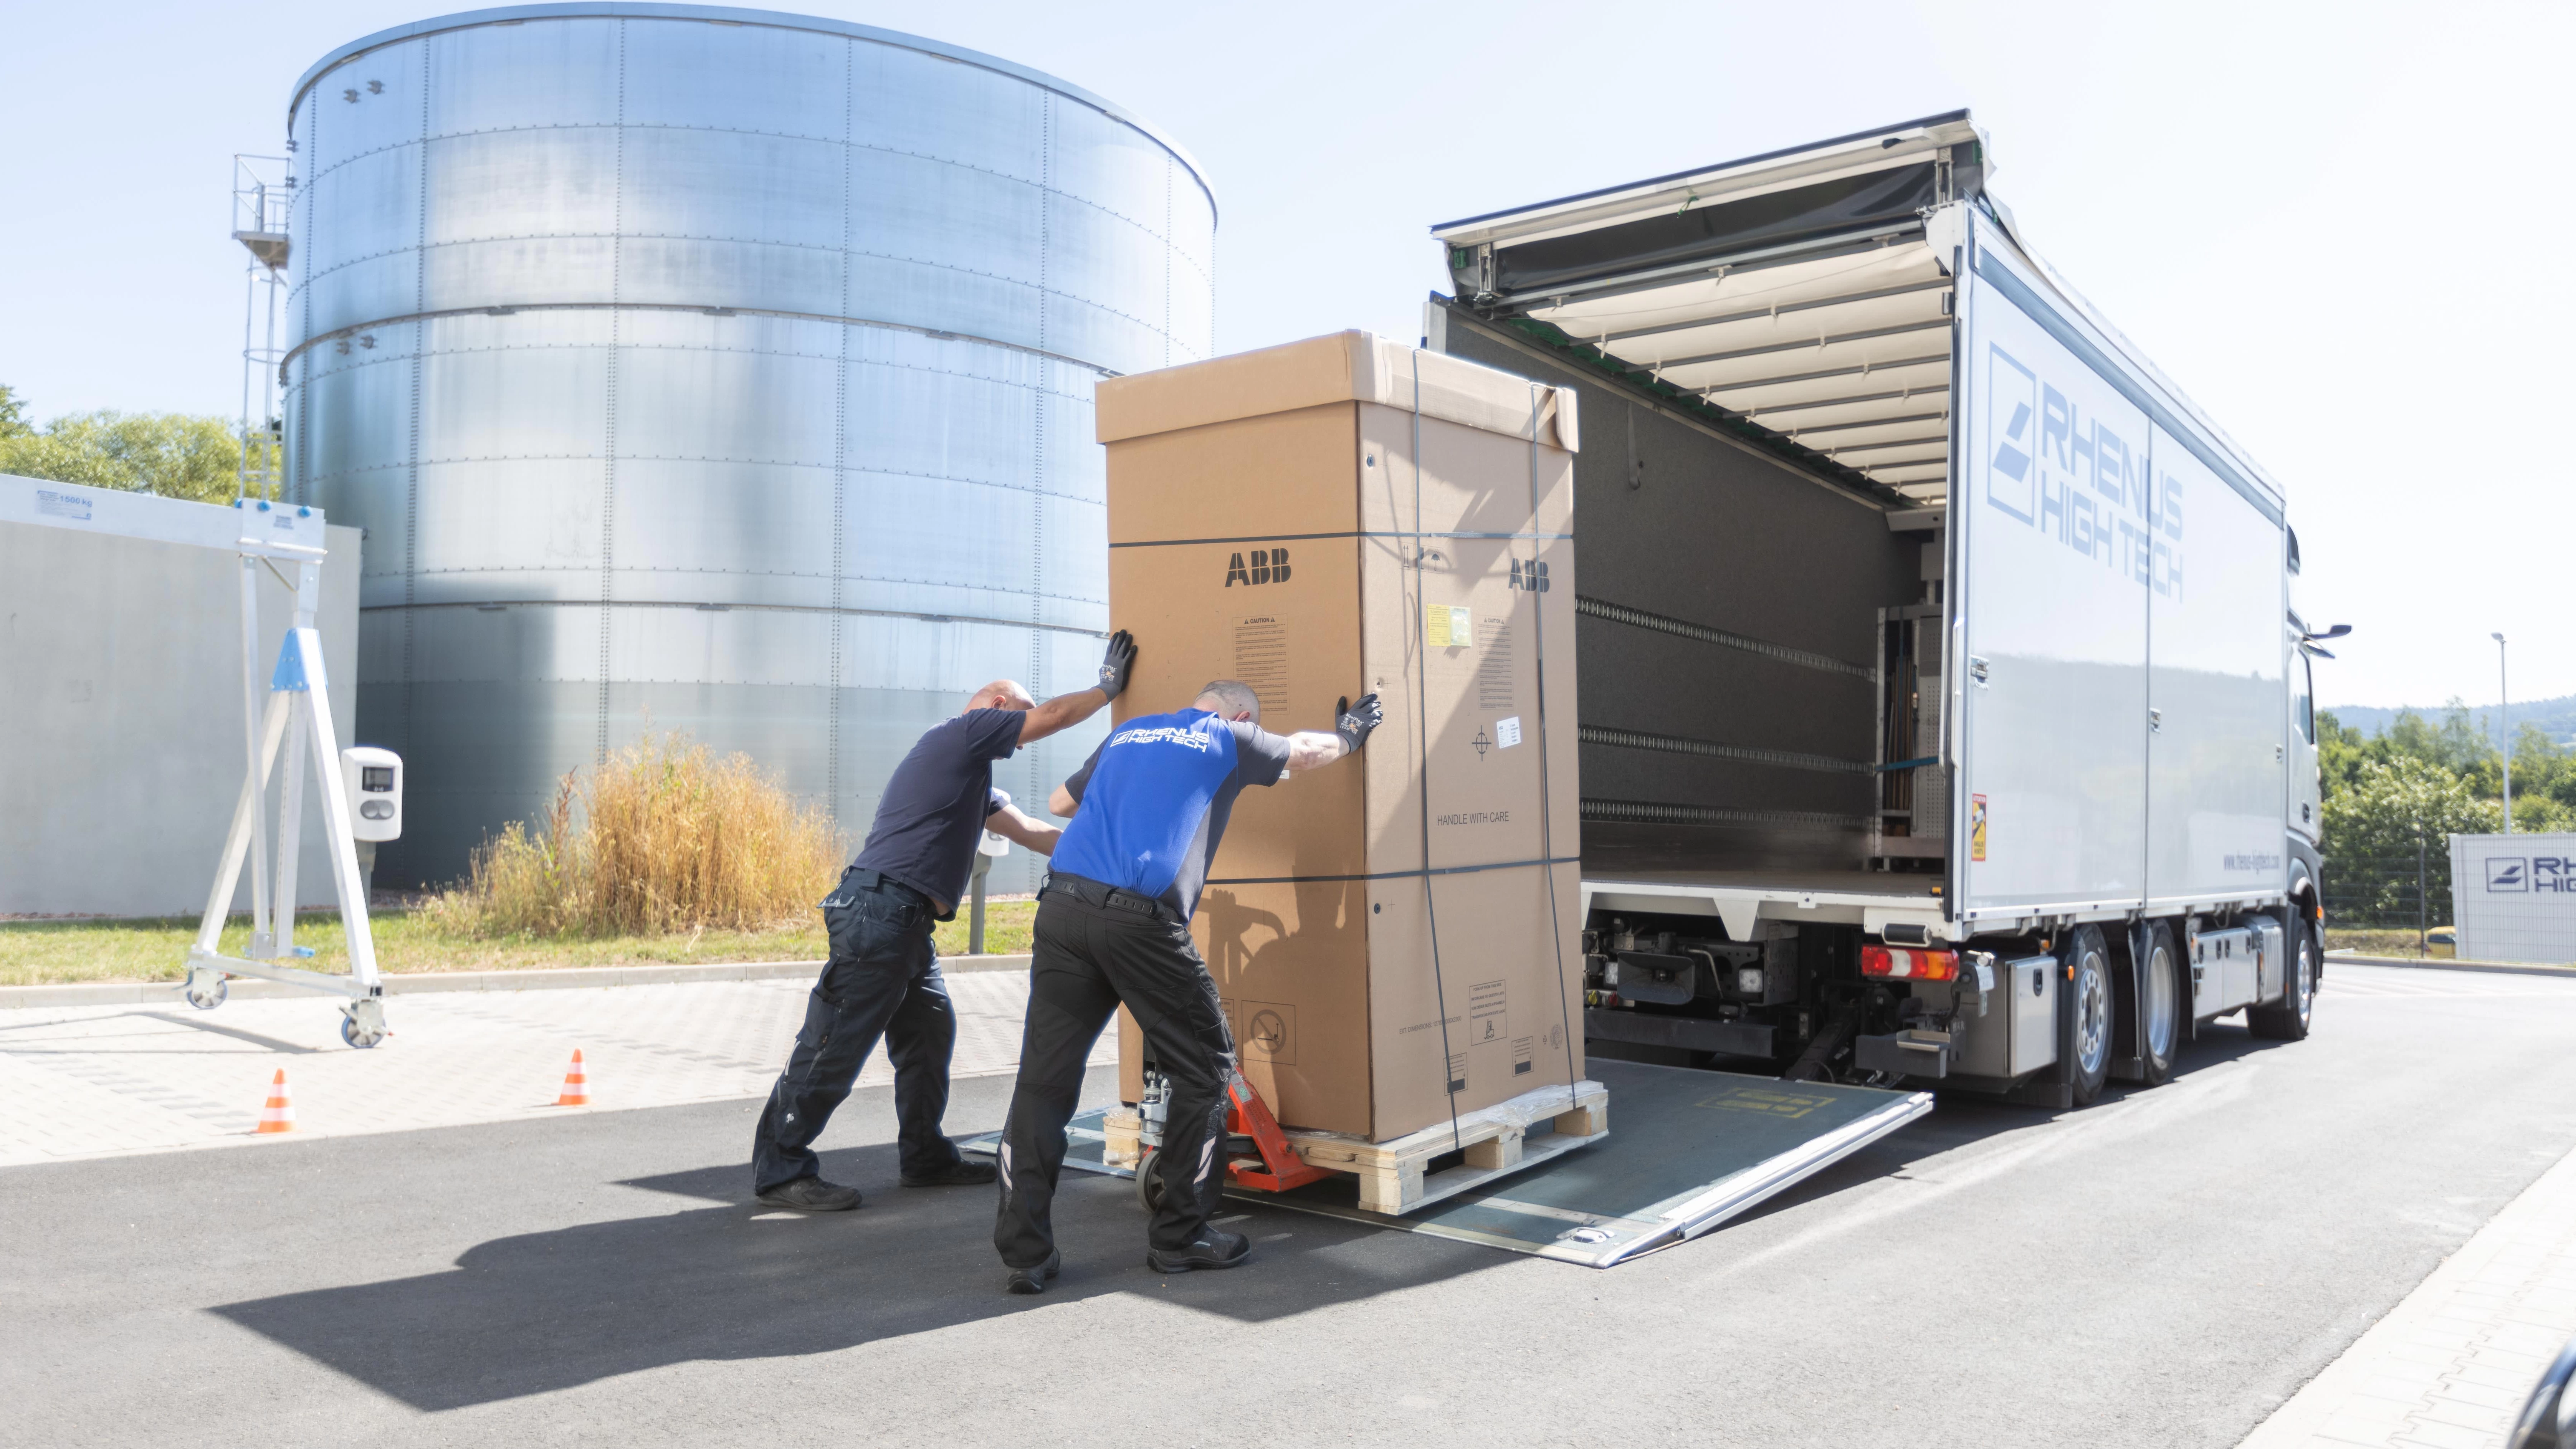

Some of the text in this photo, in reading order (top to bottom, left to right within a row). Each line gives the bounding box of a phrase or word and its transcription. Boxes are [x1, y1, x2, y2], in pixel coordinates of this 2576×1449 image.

[2043, 380, 2182, 542] RHENUS
[60, 495, 80, 504] 1500
[82, 498, 93, 507] kg
[2041, 470, 2182, 604] HIGH TECH
[1225, 548, 1291, 587] ABB
[1508, 558, 1550, 593] ABB
[1128, 735, 1207, 753] HIGH TECH
[1131, 727, 1210, 744] RHENUS
[1437, 811, 1509, 826] HANDLE WITH CARE
[1408, 1022, 1432, 1032] DIMENSIONS:
